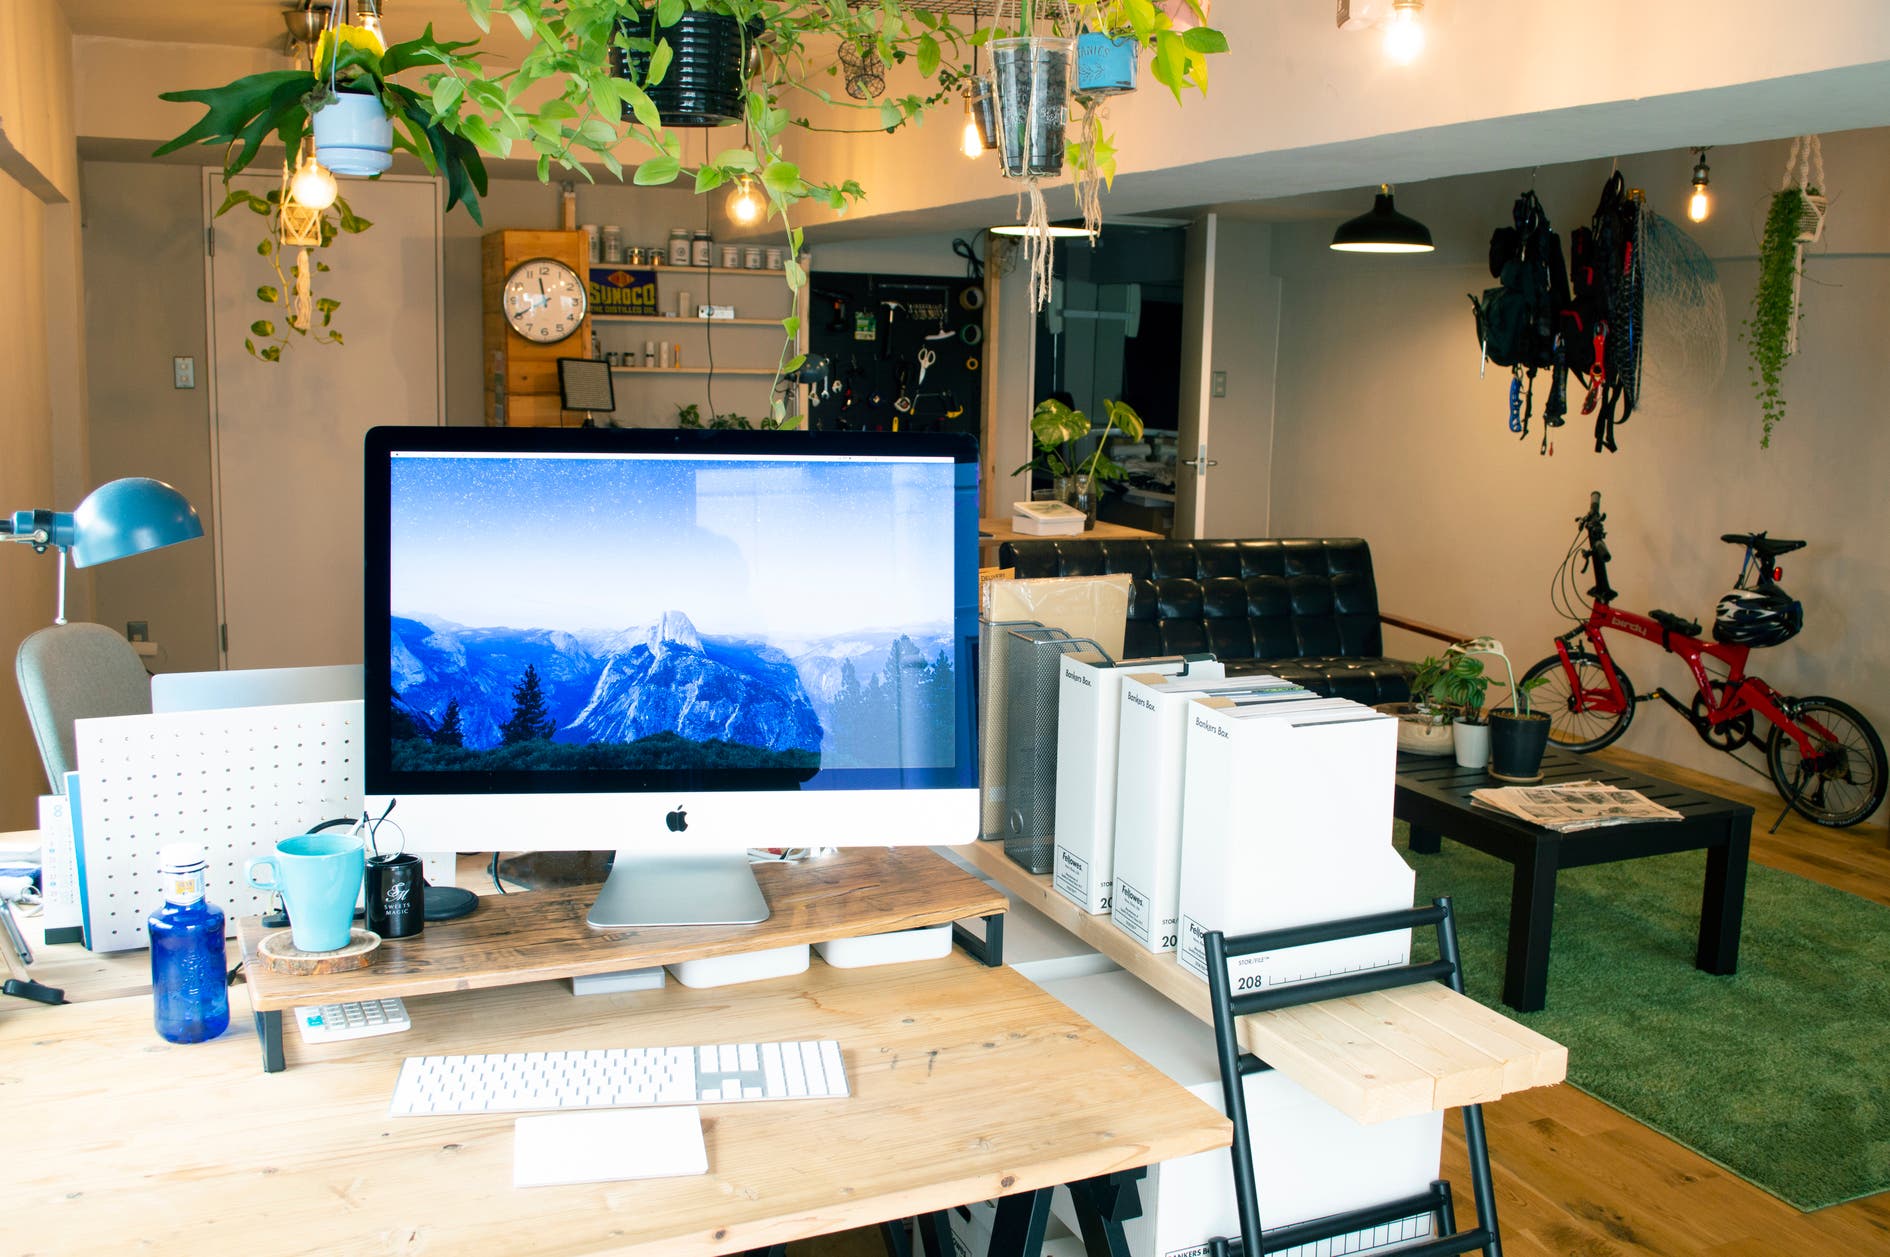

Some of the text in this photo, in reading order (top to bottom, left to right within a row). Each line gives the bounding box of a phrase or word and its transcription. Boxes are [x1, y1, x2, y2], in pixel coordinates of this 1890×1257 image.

[540, 266, 550, 275] 12
[566, 283, 574, 291] 2
[589, 281, 655, 305] SUNOCO
[572, 298, 579, 307] 3
[566, 313, 574, 321] 4
[526, 323, 533, 332] 7
[541, 328, 549, 336] 6
[556, 324, 564, 332] 5
[1612, 616, 1647, 637] birdy
[1066, 669, 1082, 683] Bankers
[1128, 691, 1145, 706] Bankers
[1195, 716, 1217, 734] Bankers
[384, 902, 410, 910] SWEETS
[1238, 975, 1262, 990] 208
